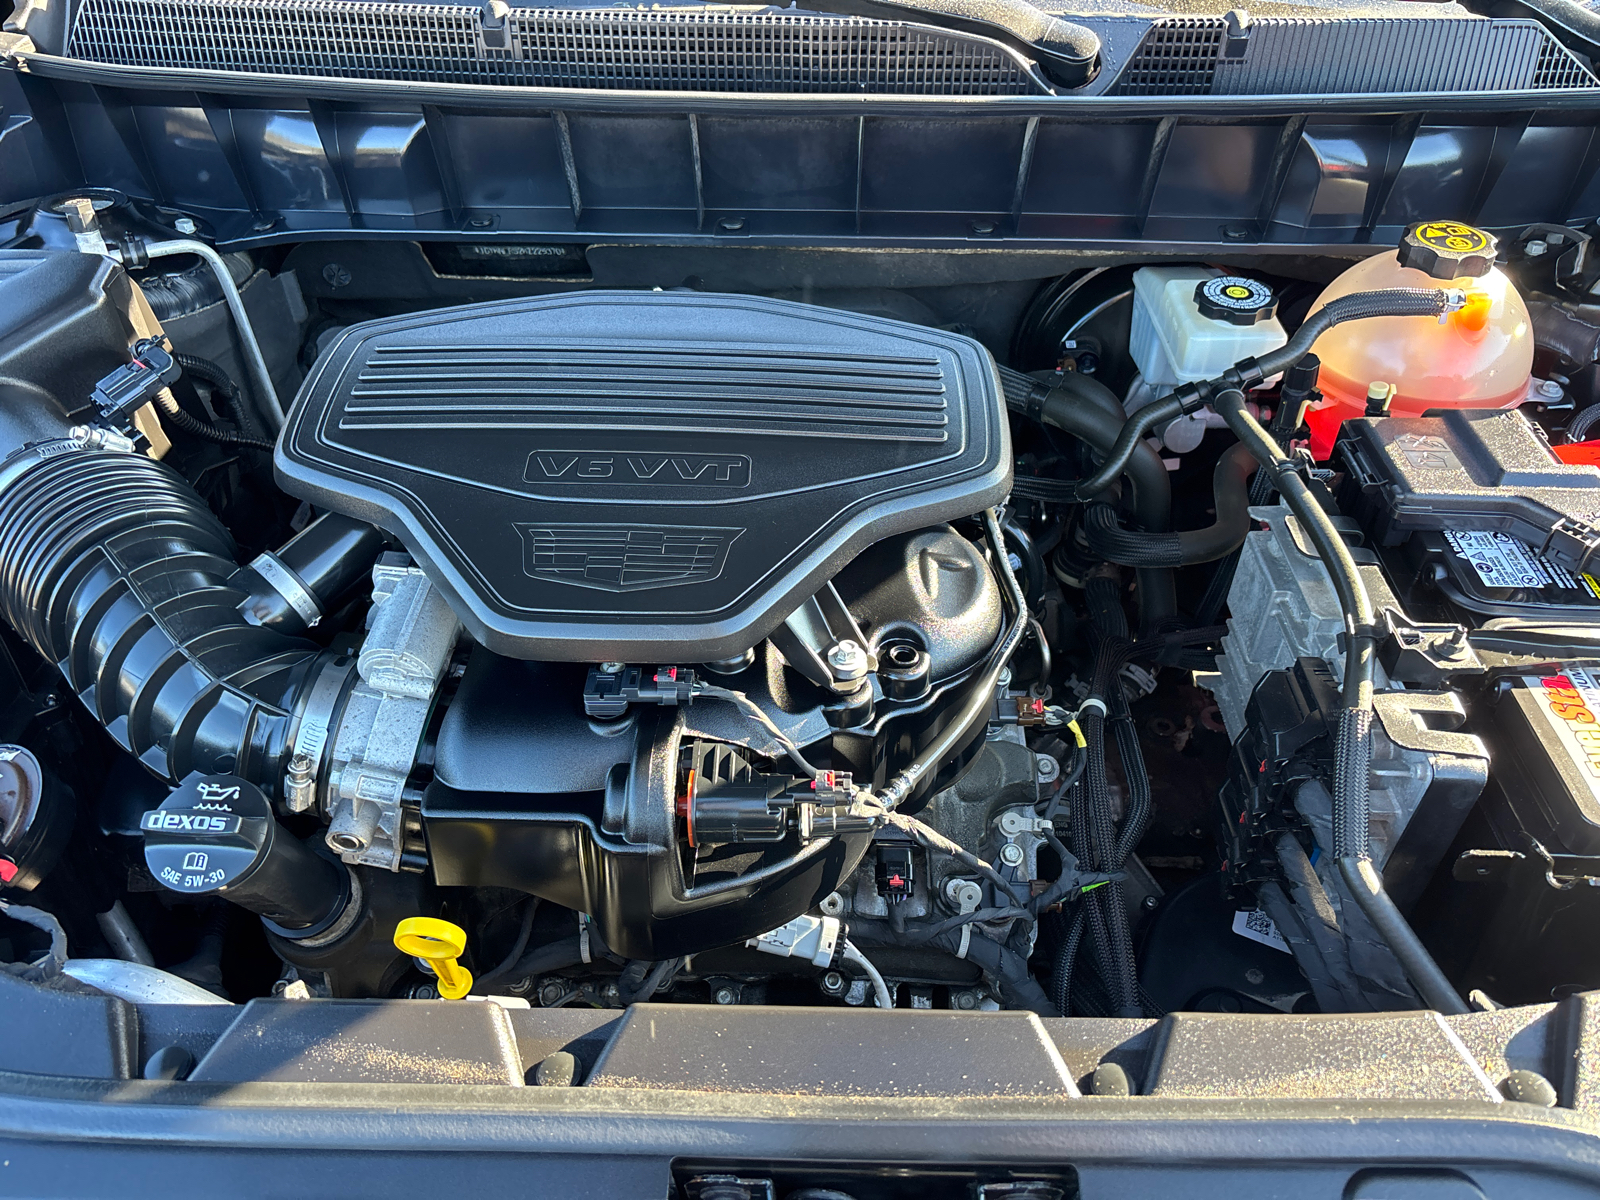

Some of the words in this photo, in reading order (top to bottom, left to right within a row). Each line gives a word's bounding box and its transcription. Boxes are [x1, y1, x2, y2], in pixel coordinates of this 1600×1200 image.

[536, 456, 614, 478] V6
[626, 458, 742, 481] VVT
[1443, 530, 1463, 553] DANG
[1540, 669, 1600, 778] verStar
[148, 811, 227, 830] dexos
[161, 866, 182, 885] SAE
[184, 869, 226, 887] 5W-30
